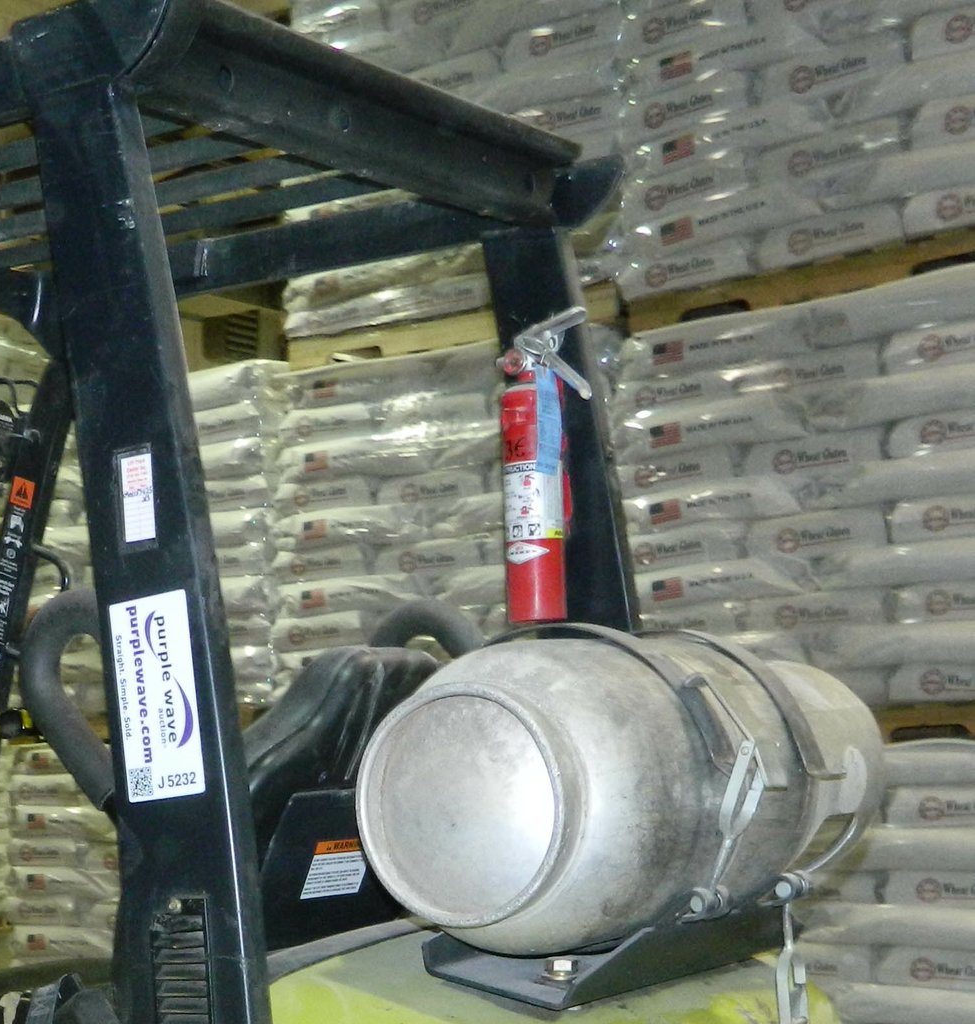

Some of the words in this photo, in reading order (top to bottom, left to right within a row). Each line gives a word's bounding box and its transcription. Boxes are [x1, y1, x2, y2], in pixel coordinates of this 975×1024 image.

[115, 634, 125, 675] Straight.
[120, 678, 129, 711] Simple.
[126, 605, 153, 764] purplewave.com
[154, 615, 173, 682] purple
[164, 688, 178, 744] wave
[124, 715, 132, 740] Sold.
[157, 707, 168, 745] auction
